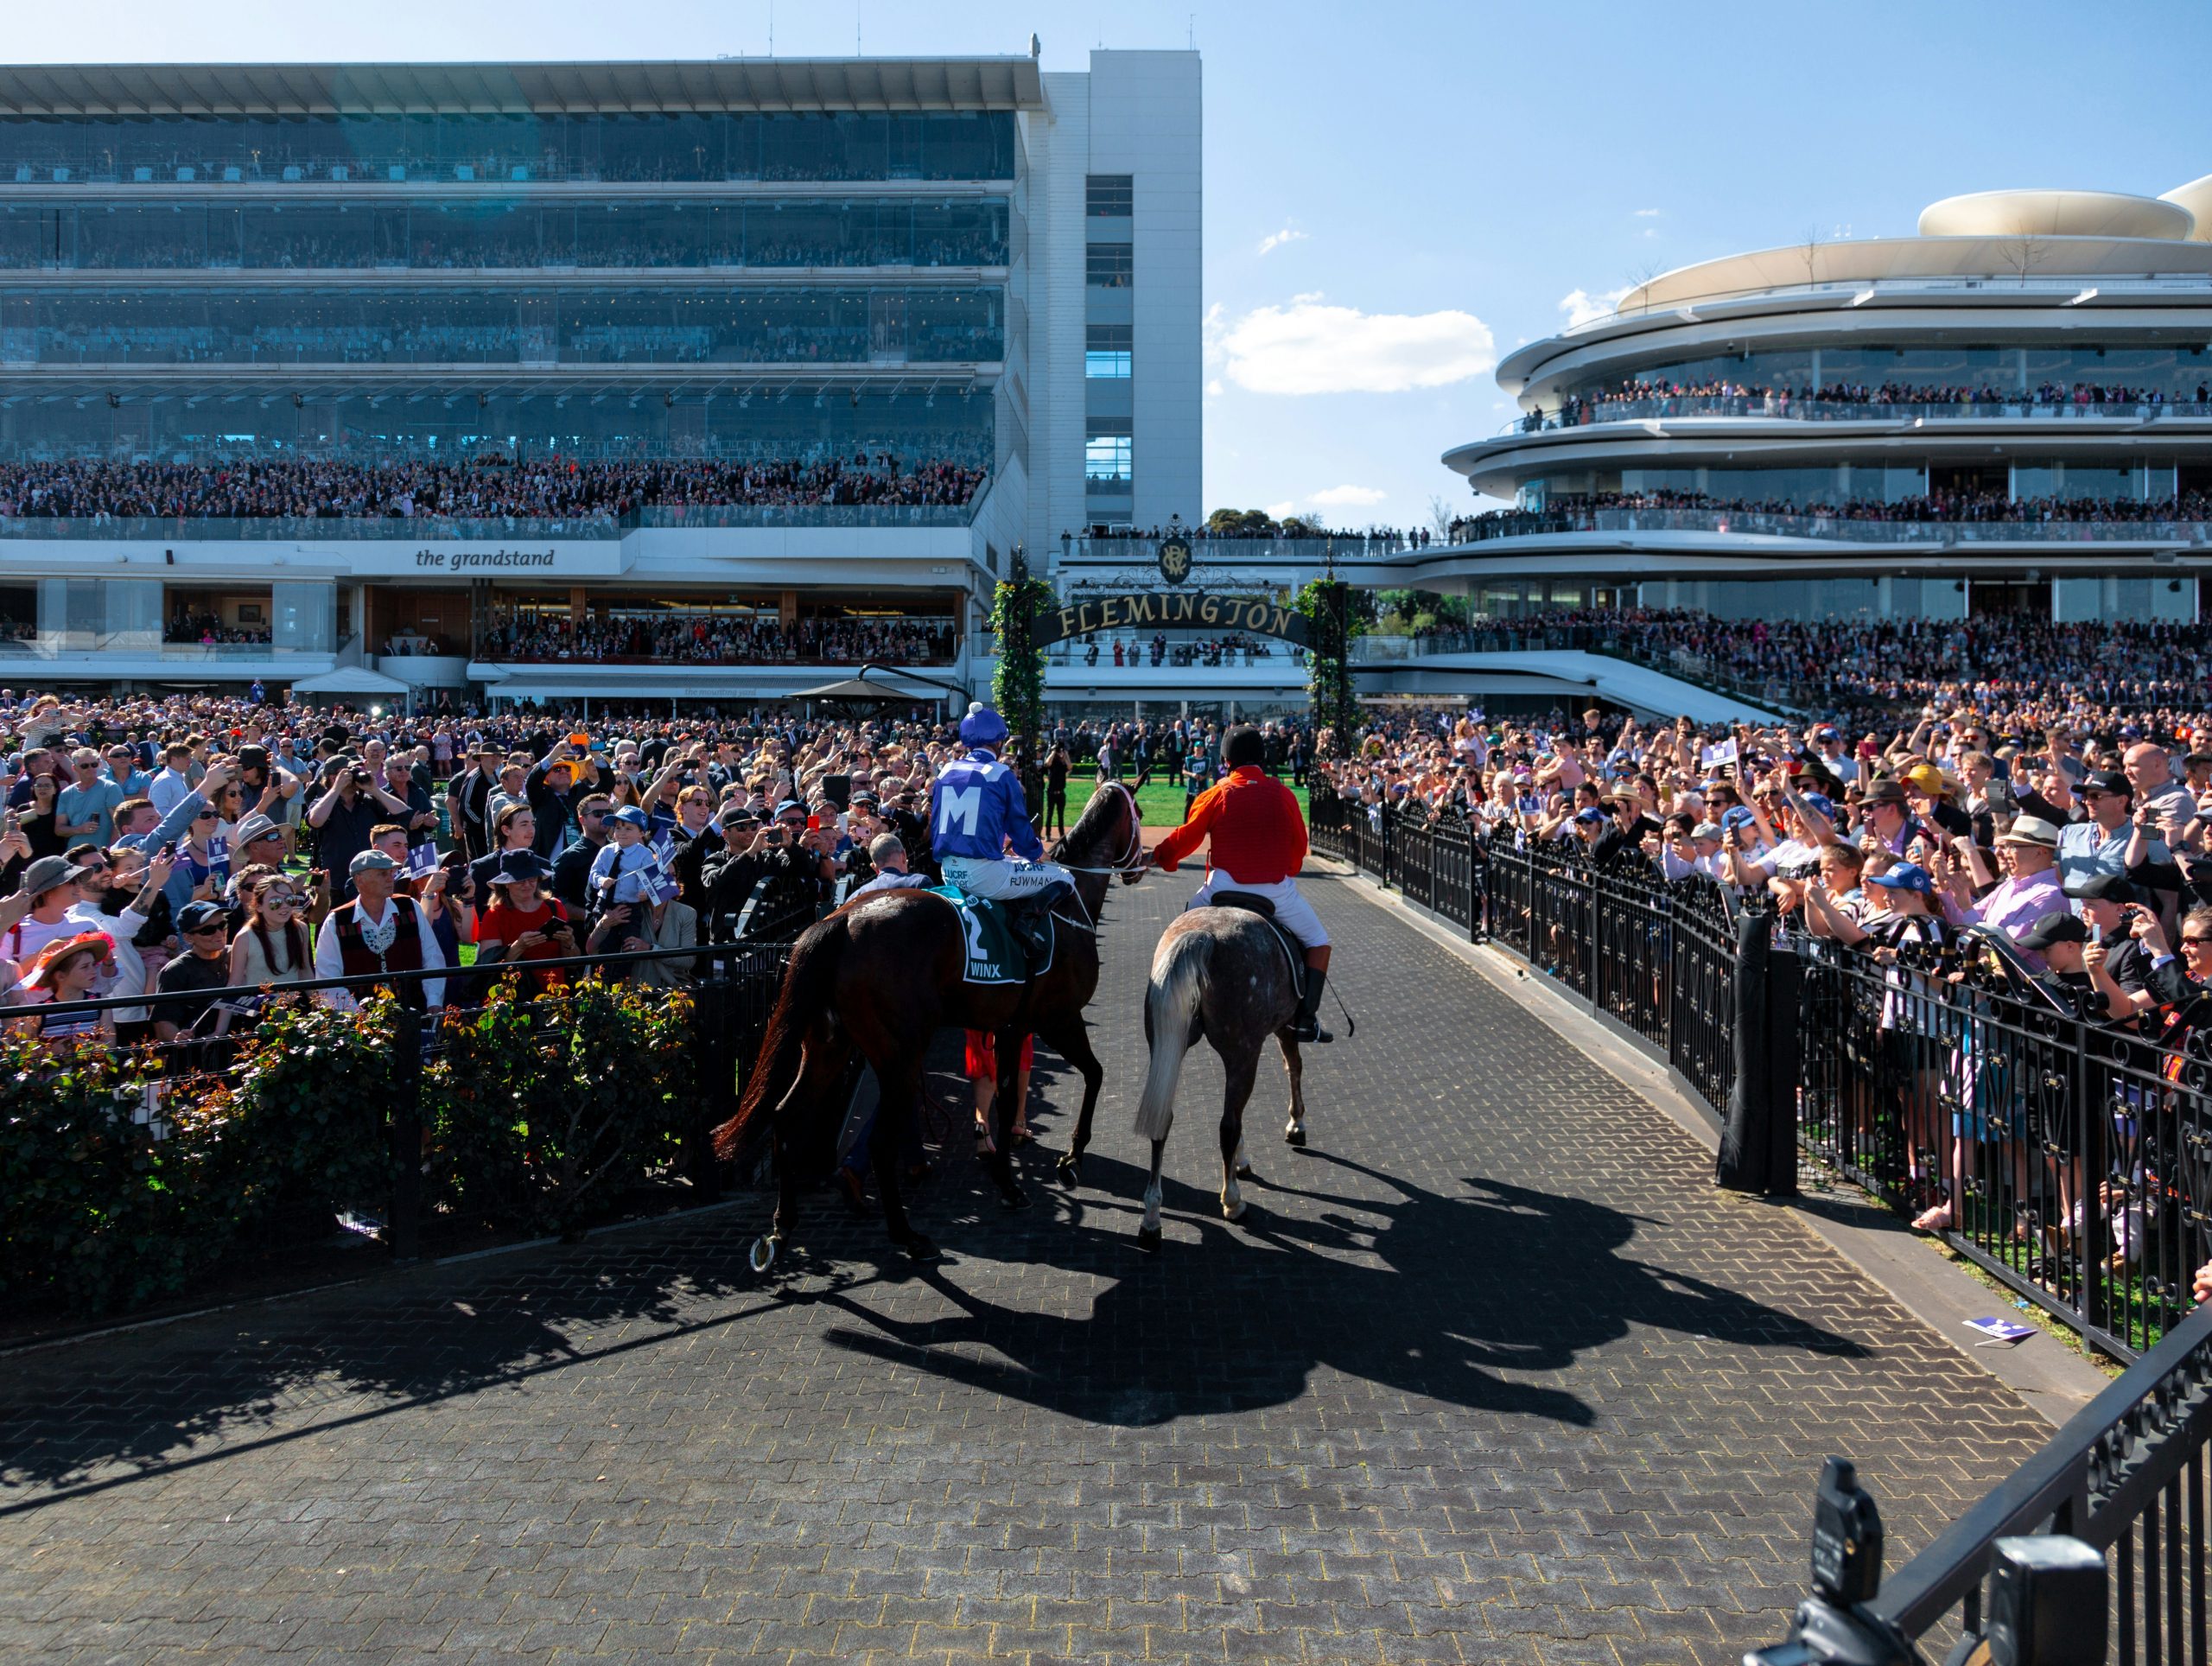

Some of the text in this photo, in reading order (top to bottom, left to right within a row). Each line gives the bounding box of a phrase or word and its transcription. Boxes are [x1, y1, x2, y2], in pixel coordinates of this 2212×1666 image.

[416, 549, 555, 571] the grandstand
[1057, 594, 1294, 638] FLEMINGTON
[938, 786, 982, 836] M
[214, 843, 222, 855] M
[415, 853, 423, 868] M
[651, 874, 668, 891] M
[961, 906, 988, 960] 2
[970, 961, 1002, 978] WINX
[235, 995, 257, 1007] M
